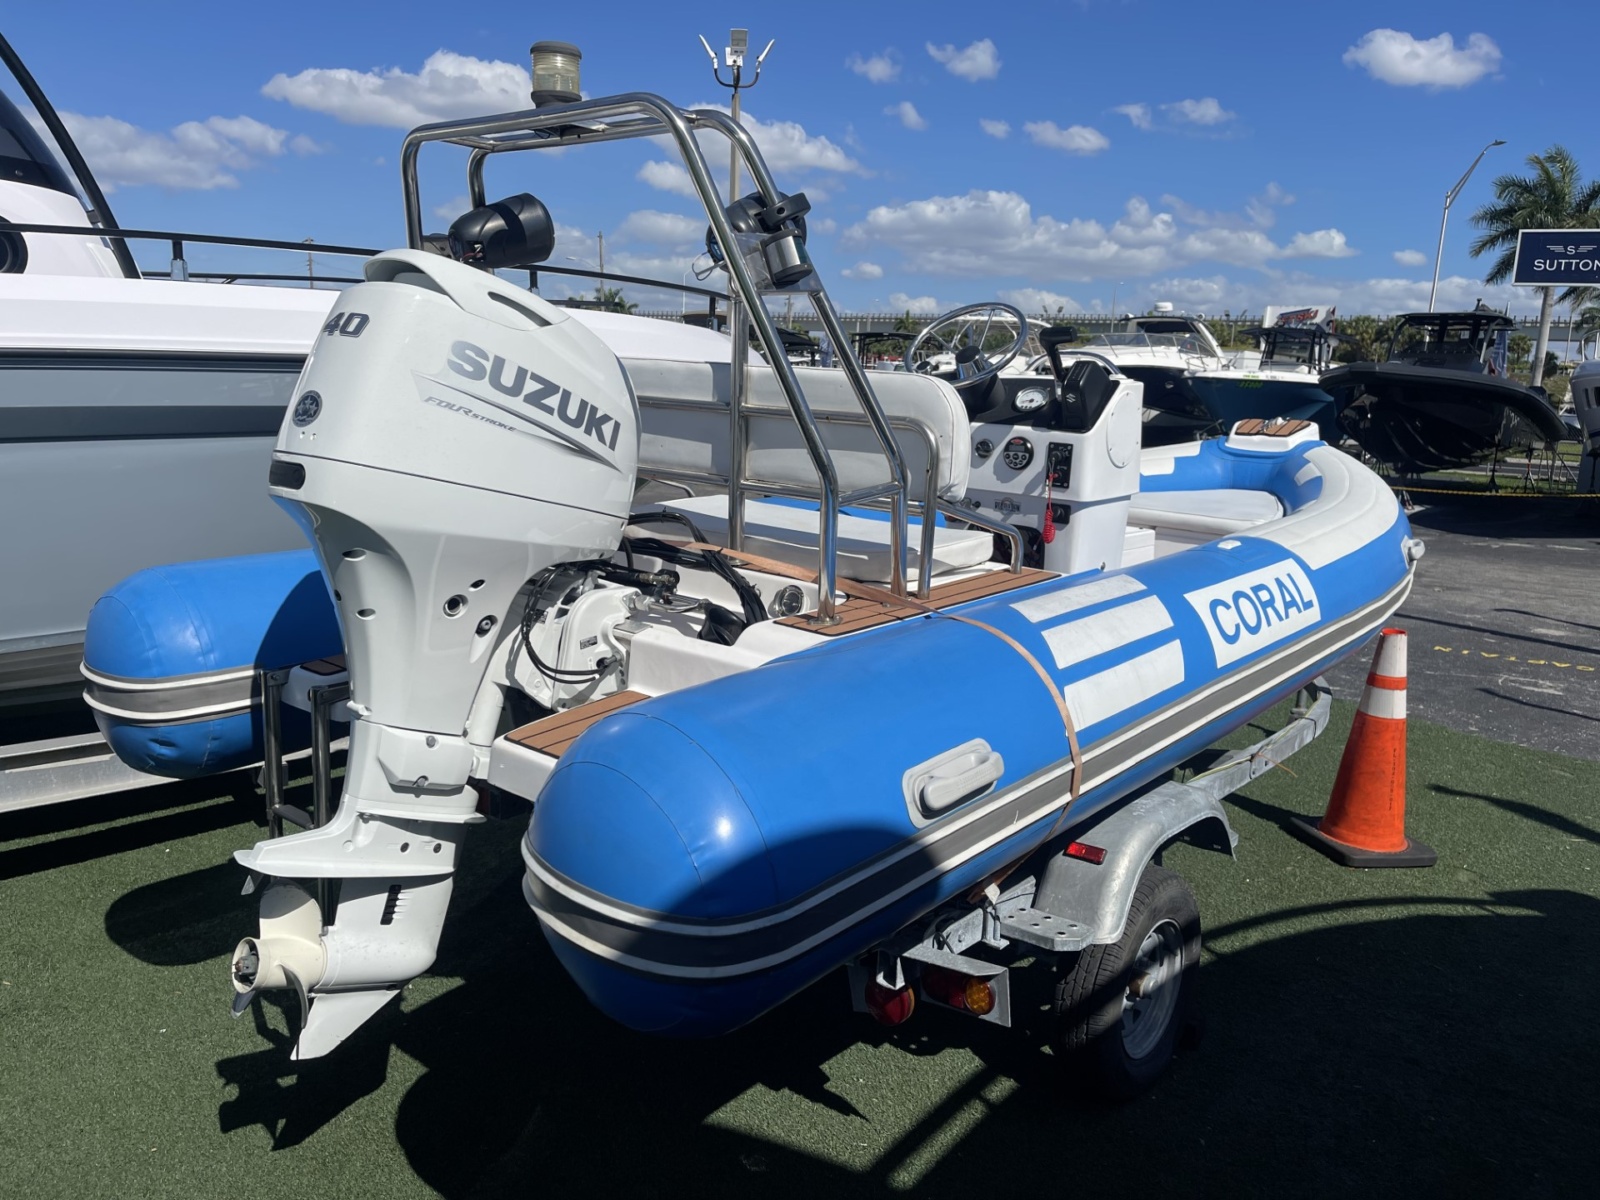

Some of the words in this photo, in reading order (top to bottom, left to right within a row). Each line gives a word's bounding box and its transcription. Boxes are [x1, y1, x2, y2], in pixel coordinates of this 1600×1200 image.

[1566, 245, 1576, 255] S
[322, 312, 370, 338] 40
[447, 340, 621, 452] SUZUKI
[1209, 573, 1315, 645] CORAL
